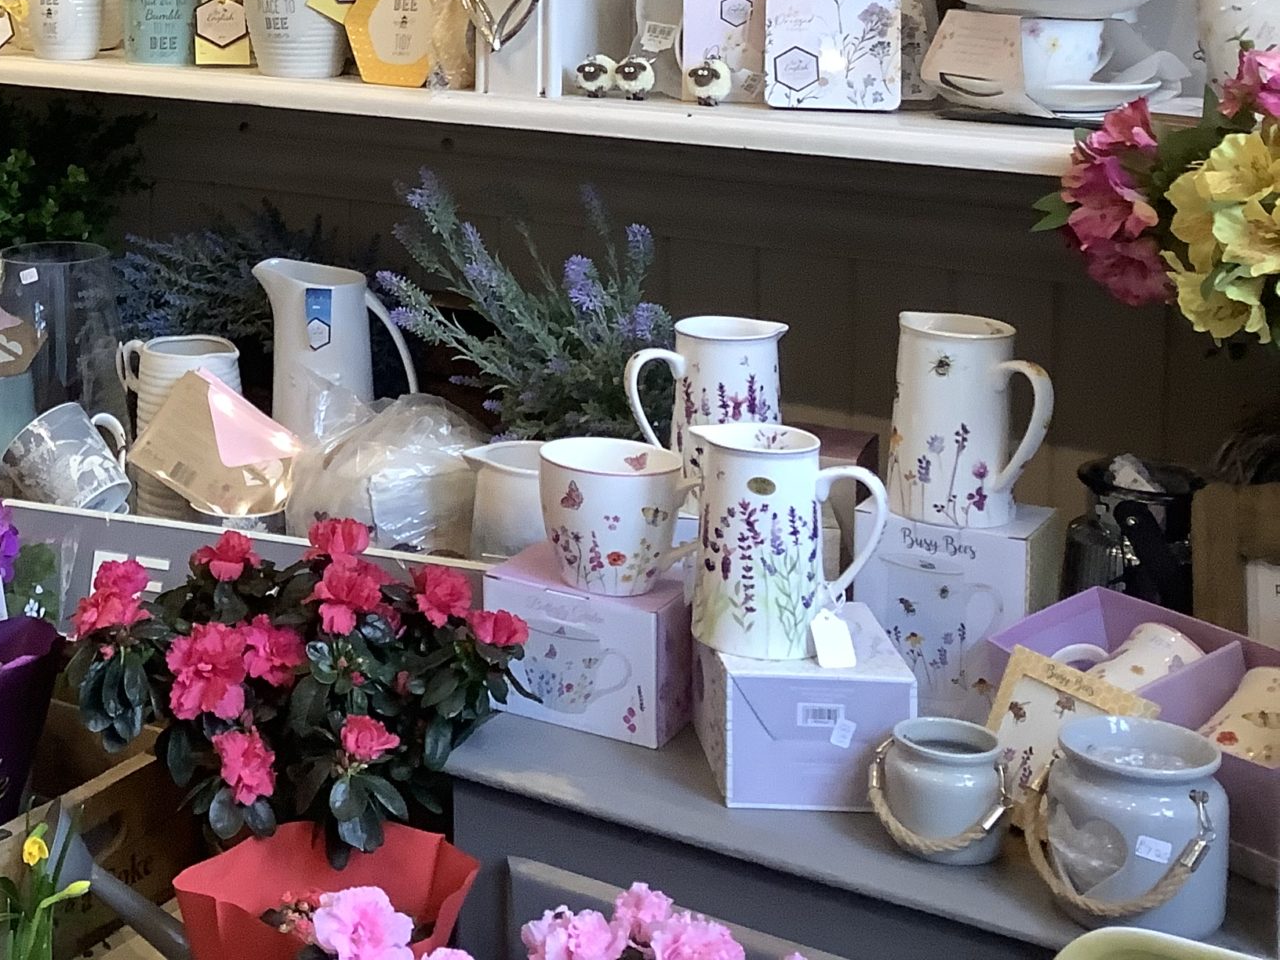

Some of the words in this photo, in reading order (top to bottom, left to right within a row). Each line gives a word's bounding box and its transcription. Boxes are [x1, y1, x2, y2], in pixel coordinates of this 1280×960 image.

[264, 17, 289, 30] BEE
[149, 36, 178, 51] BEE
[900, 527, 938, 554] Busy
[942, 535, 976, 560] Bees
